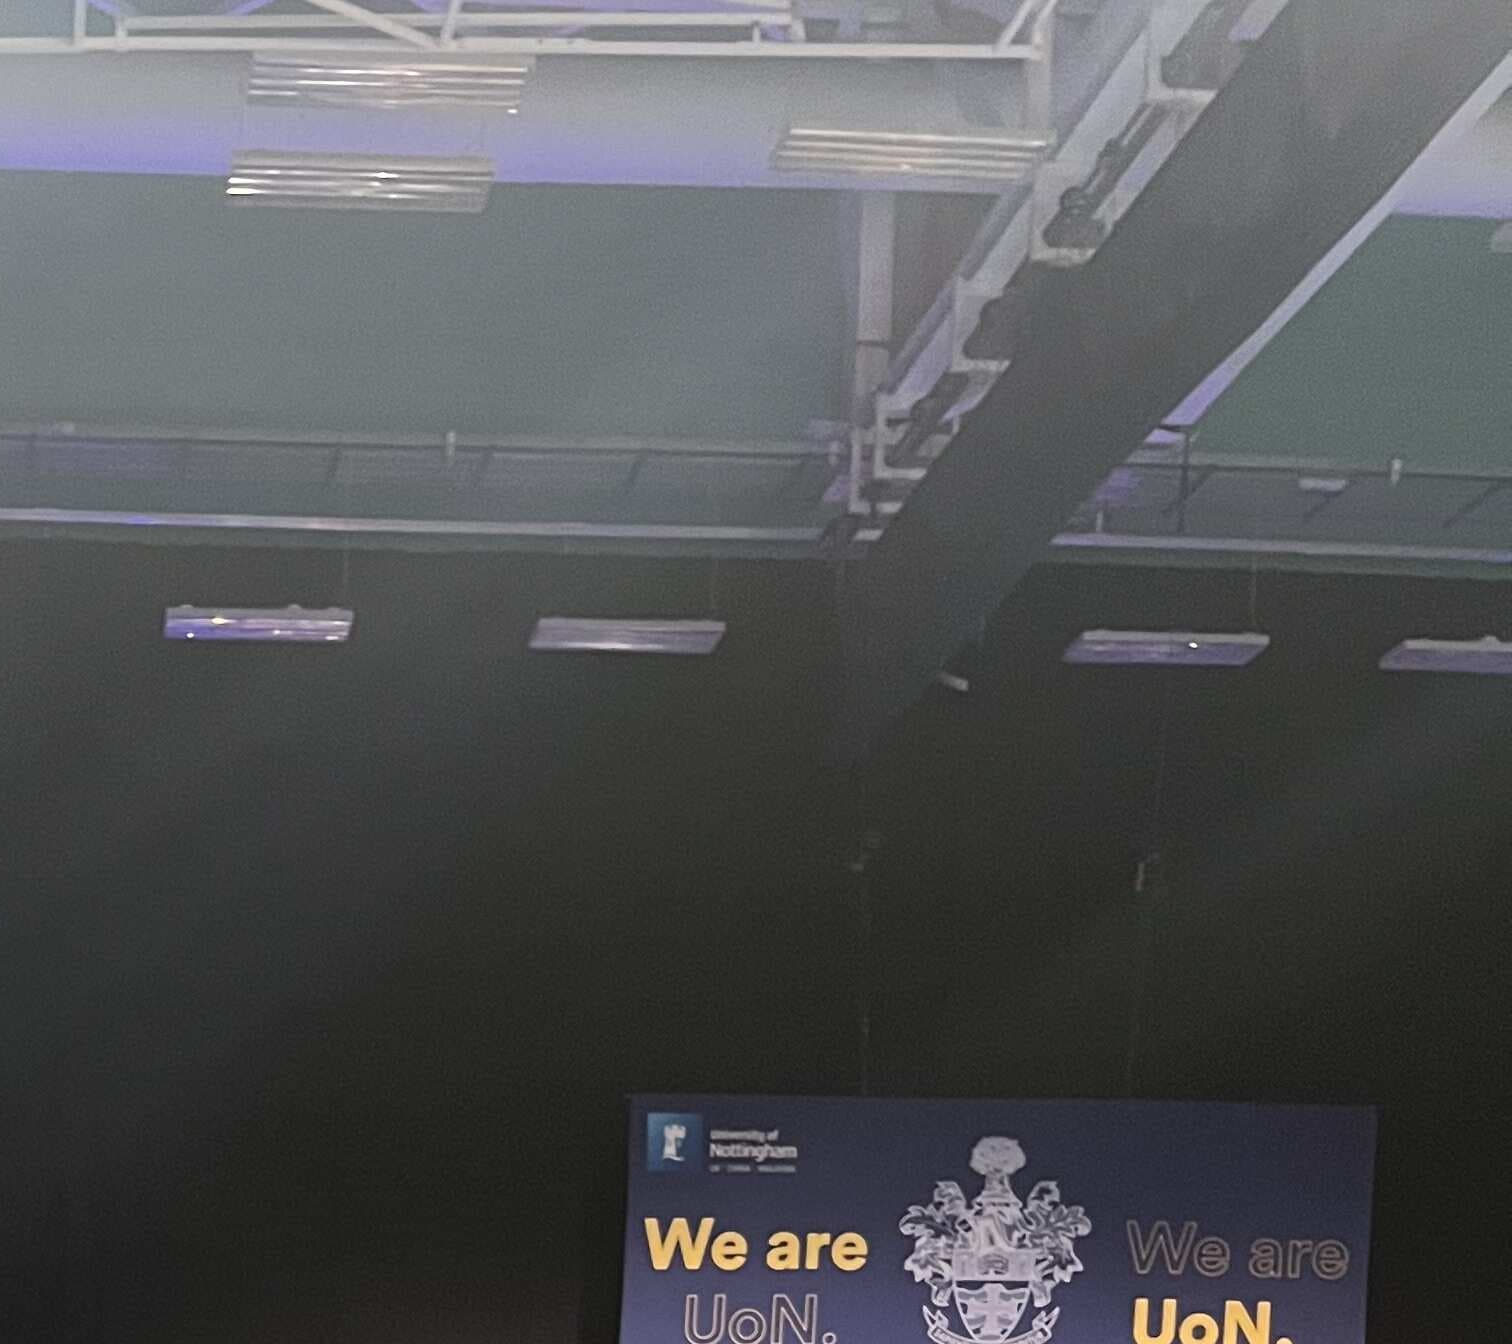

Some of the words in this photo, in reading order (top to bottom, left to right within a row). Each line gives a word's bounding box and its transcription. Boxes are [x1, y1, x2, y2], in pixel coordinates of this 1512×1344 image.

[644, 1217, 748, 1271] We
[766, 1231, 868, 1271] are
[1126, 1220, 1230, 1277] We
[1248, 1238, 1350, 1280] are
